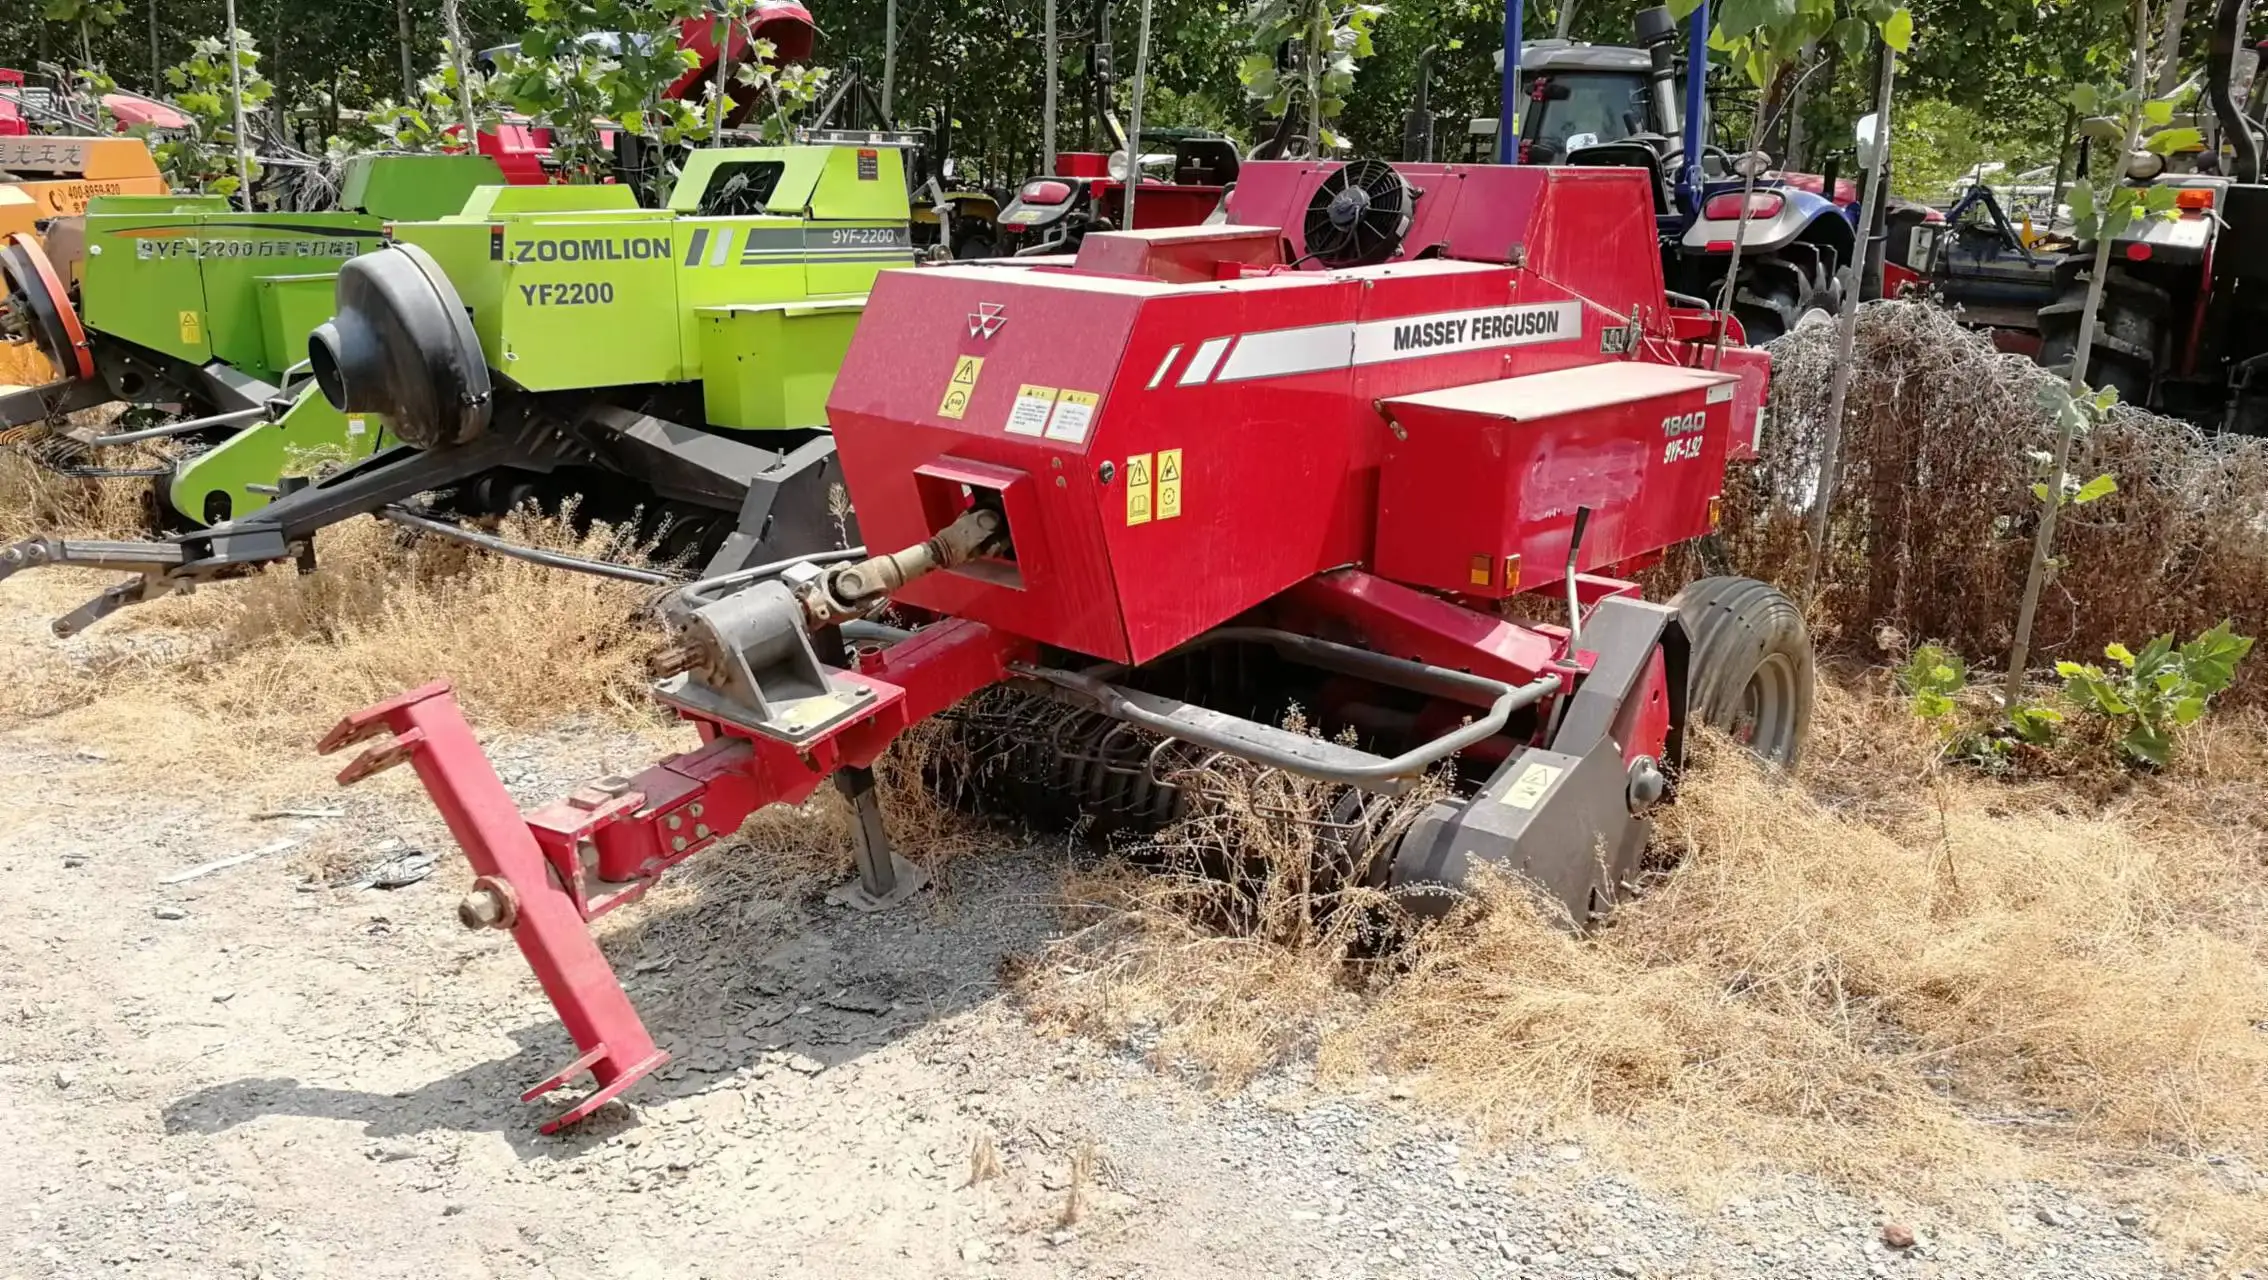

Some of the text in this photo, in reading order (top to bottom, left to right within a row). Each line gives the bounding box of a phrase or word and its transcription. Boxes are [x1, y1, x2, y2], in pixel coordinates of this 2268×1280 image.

[515, 237, 672, 262] ZOOMLION
[832, 229, 894, 244] 9YF-2200
[519, 282, 614, 306] YF2200
[1393, 310, 1560, 351] MASSEY FERGUSON
[1661, 411, 1706, 438] 1840
[1663, 435, 1704, 464] 9YF-1.92
